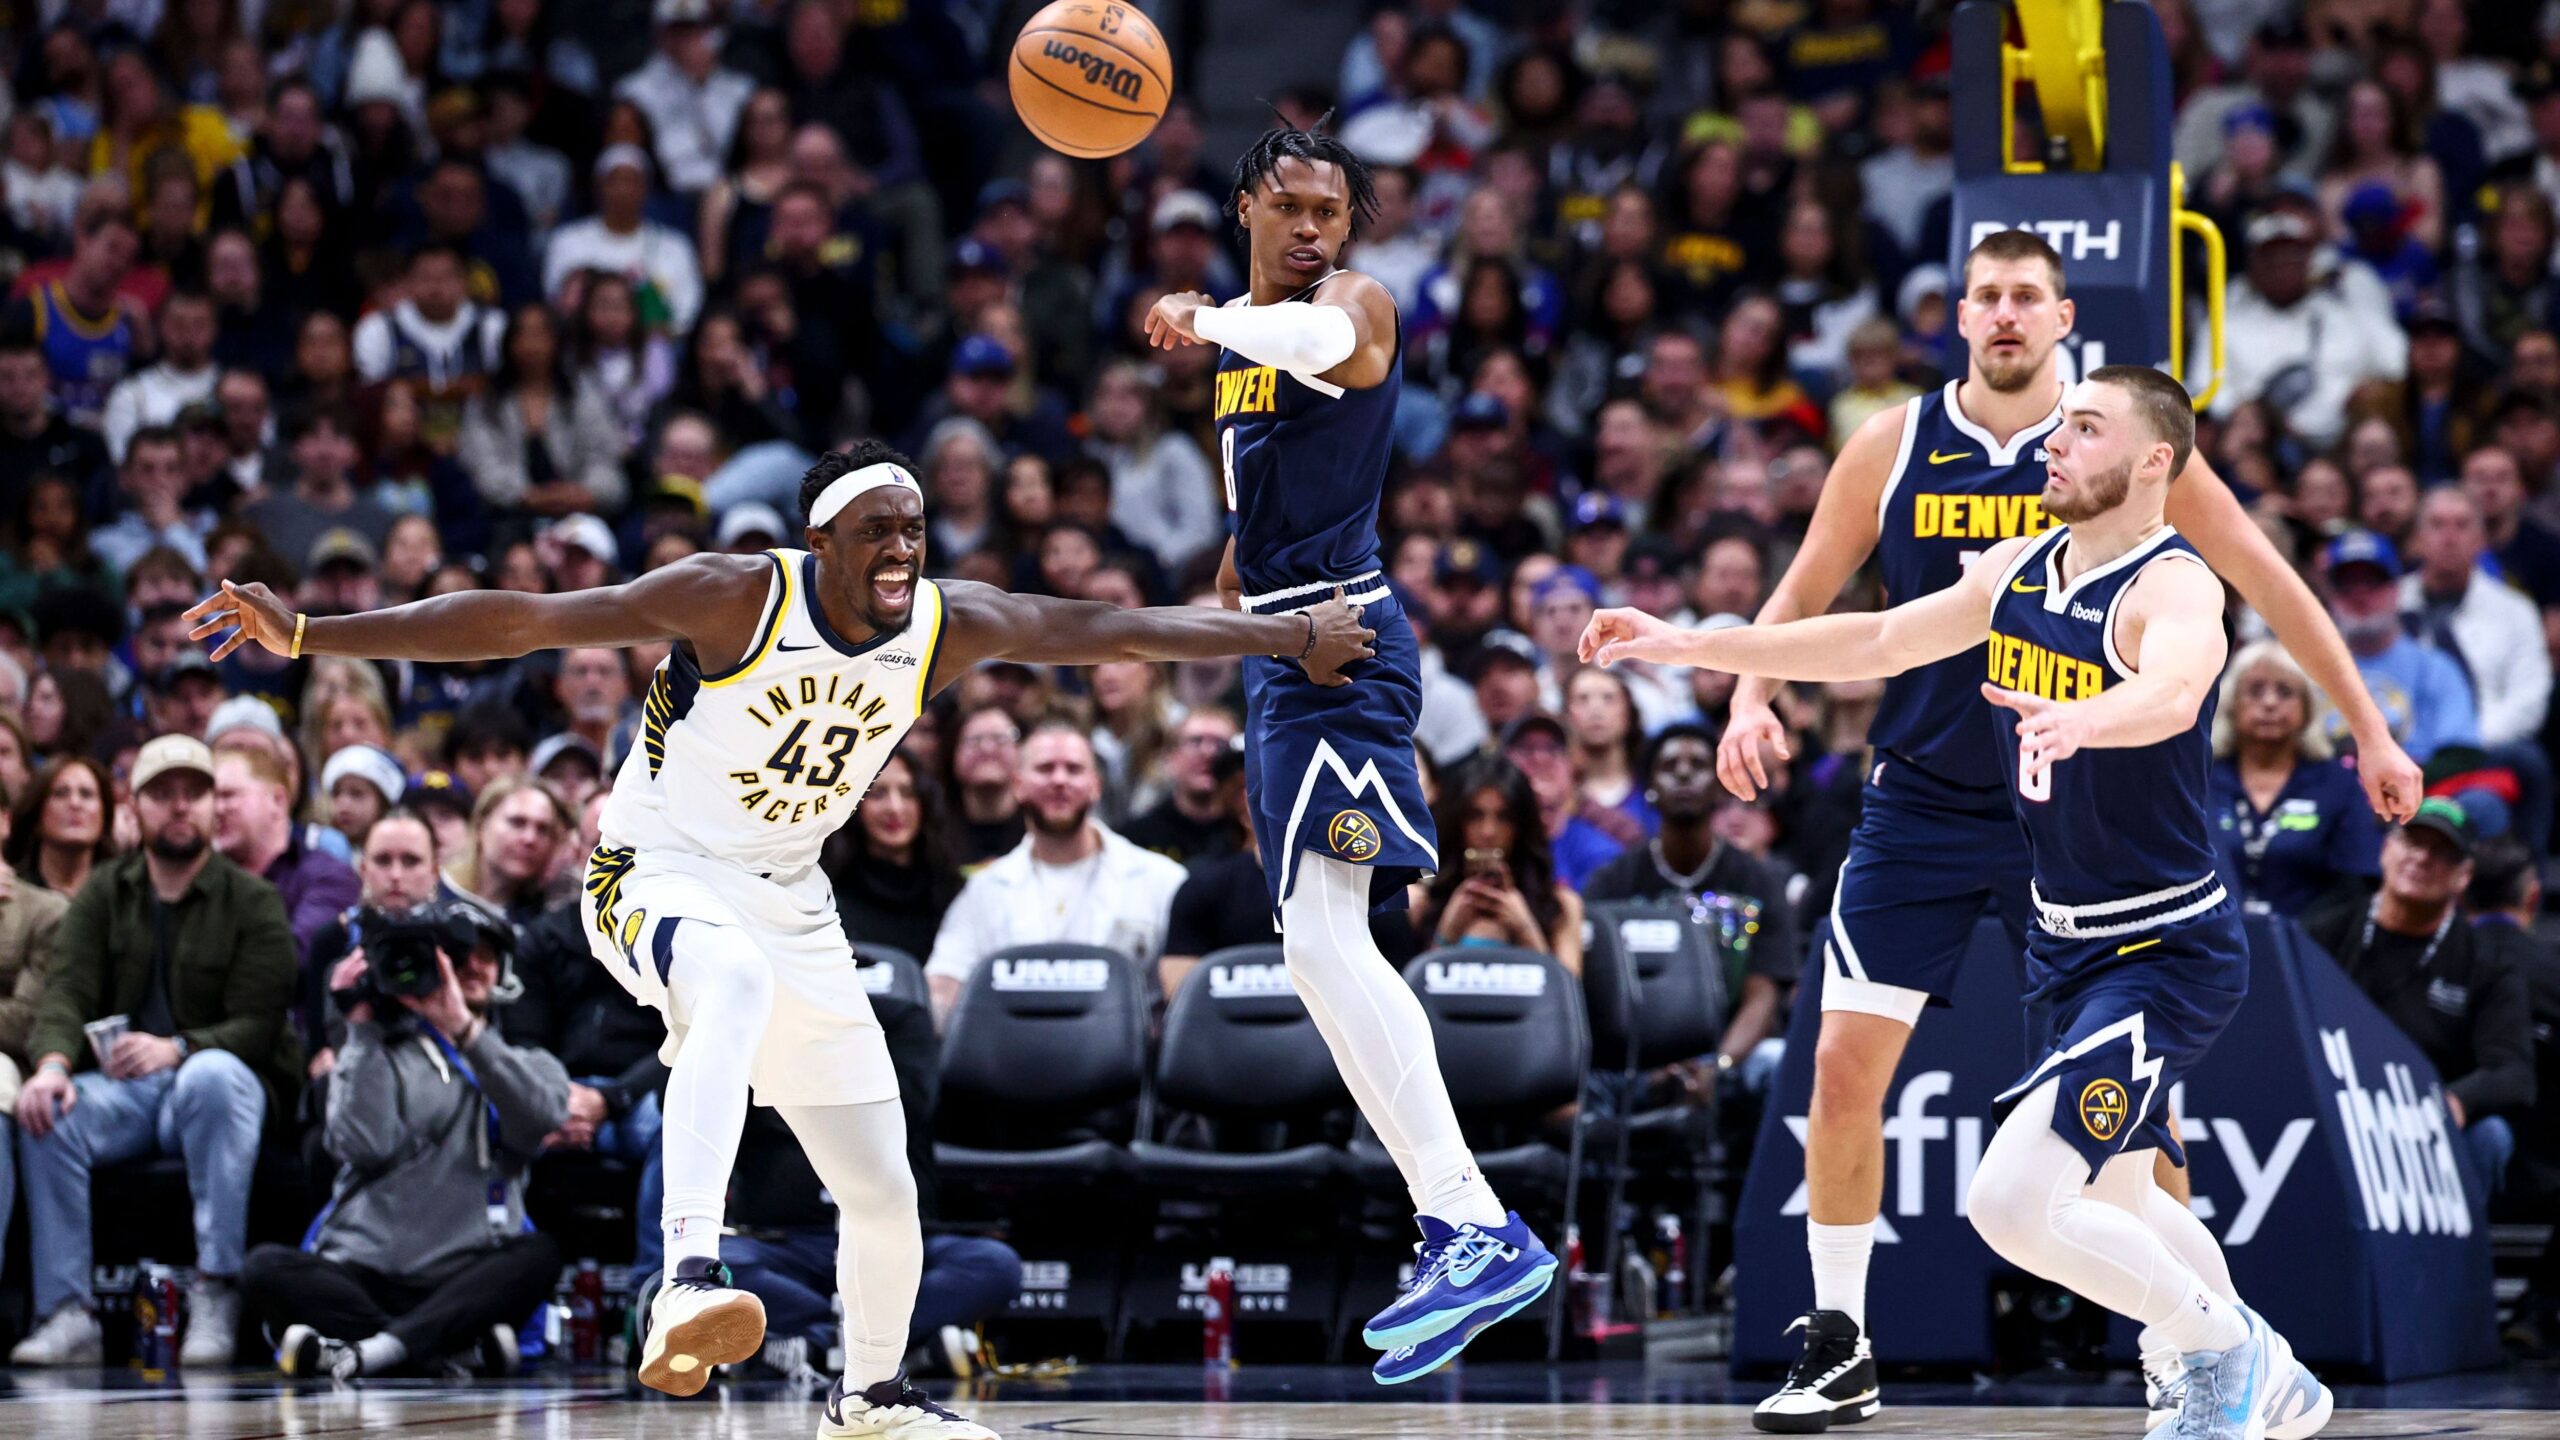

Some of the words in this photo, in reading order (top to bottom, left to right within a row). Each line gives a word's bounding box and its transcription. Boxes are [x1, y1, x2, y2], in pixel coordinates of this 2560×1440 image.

[1043, 39, 1143, 103] Wilson
[1221, 427, 1237, 511] 8
[1914, 493, 2064, 539] DENVE
[874, 653, 902, 664] LUCAS
[902, 656, 917, 666] OIL
[1987, 629, 2103, 703] DENVER
[747, 674, 892, 742] INDIANA
[765, 718, 859, 787] 43
[730, 771, 851, 824] PACERS
[992, 959, 1109, 989] UMB
[1209, 964, 1293, 995] UM
[1425, 963, 1546, 994] UMB
[2319, 1027, 2473, 1238] ibotta
